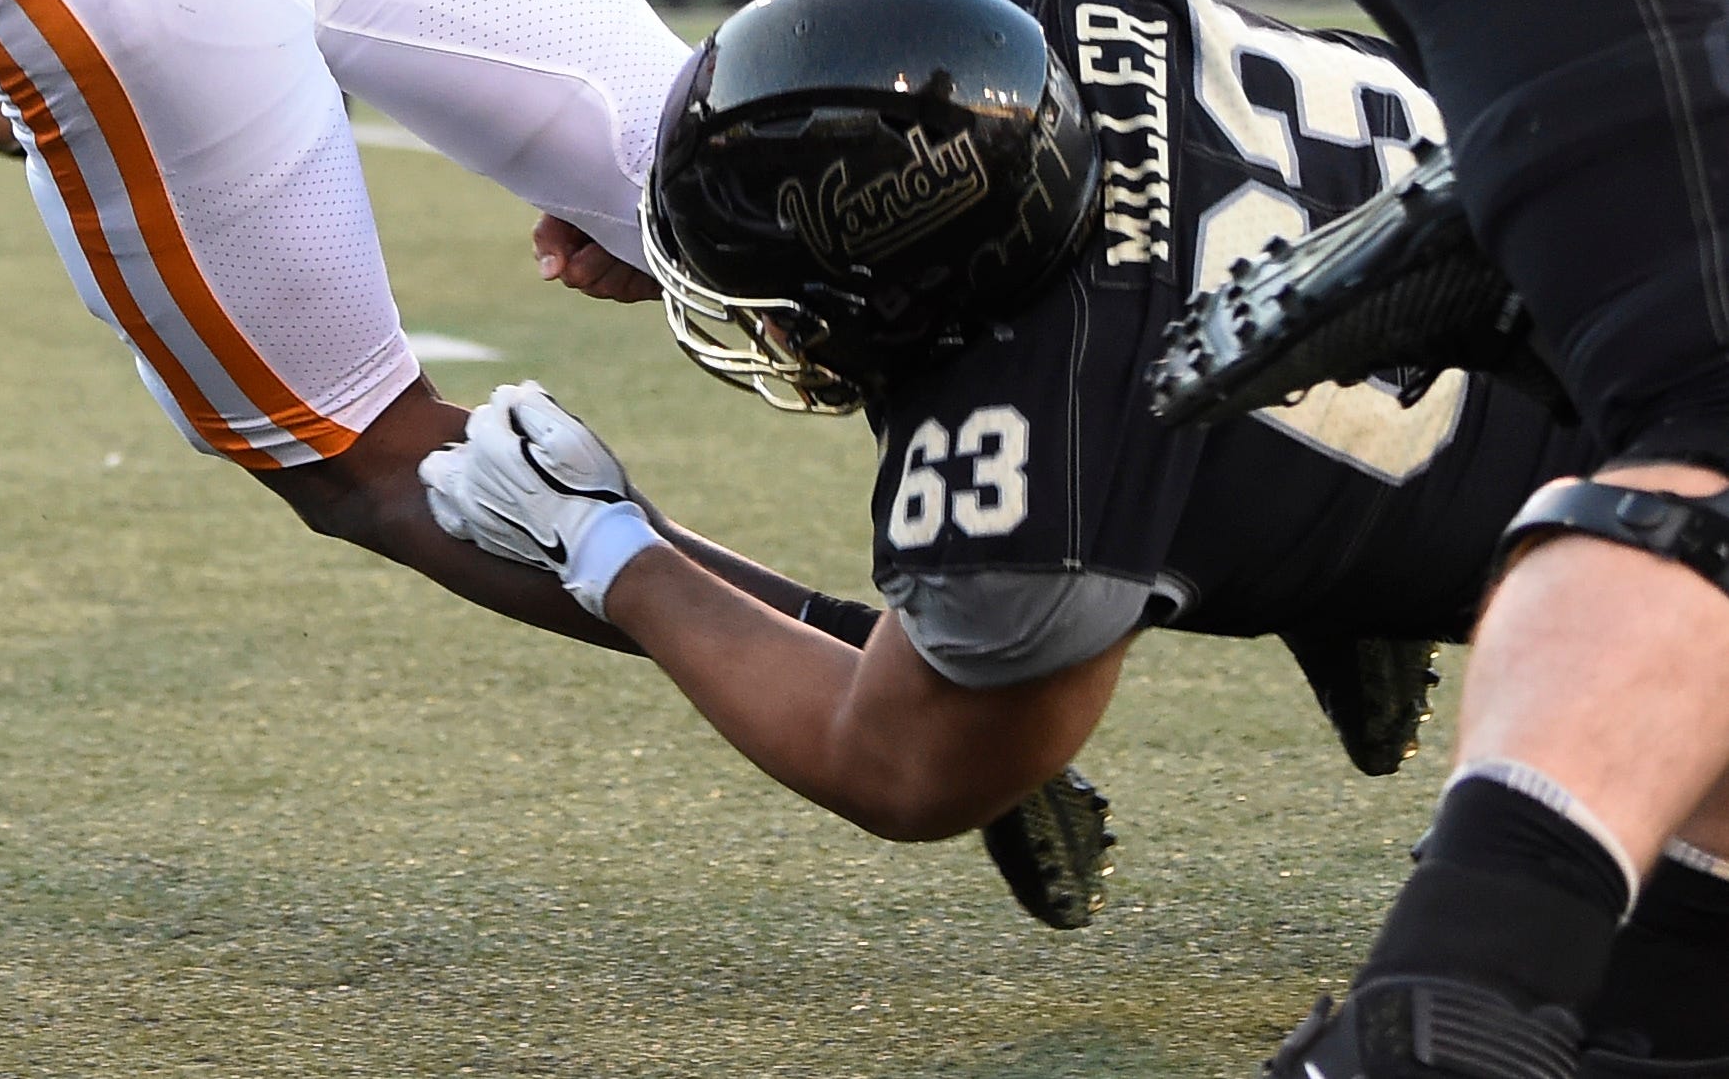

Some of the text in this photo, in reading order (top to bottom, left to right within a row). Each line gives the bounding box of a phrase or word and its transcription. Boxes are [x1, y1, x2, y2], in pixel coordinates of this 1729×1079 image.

[776, 125, 991, 279] Vandy
[1075, 2, 1169, 267] MILLER
[887, 404, 1030, 552] 63
